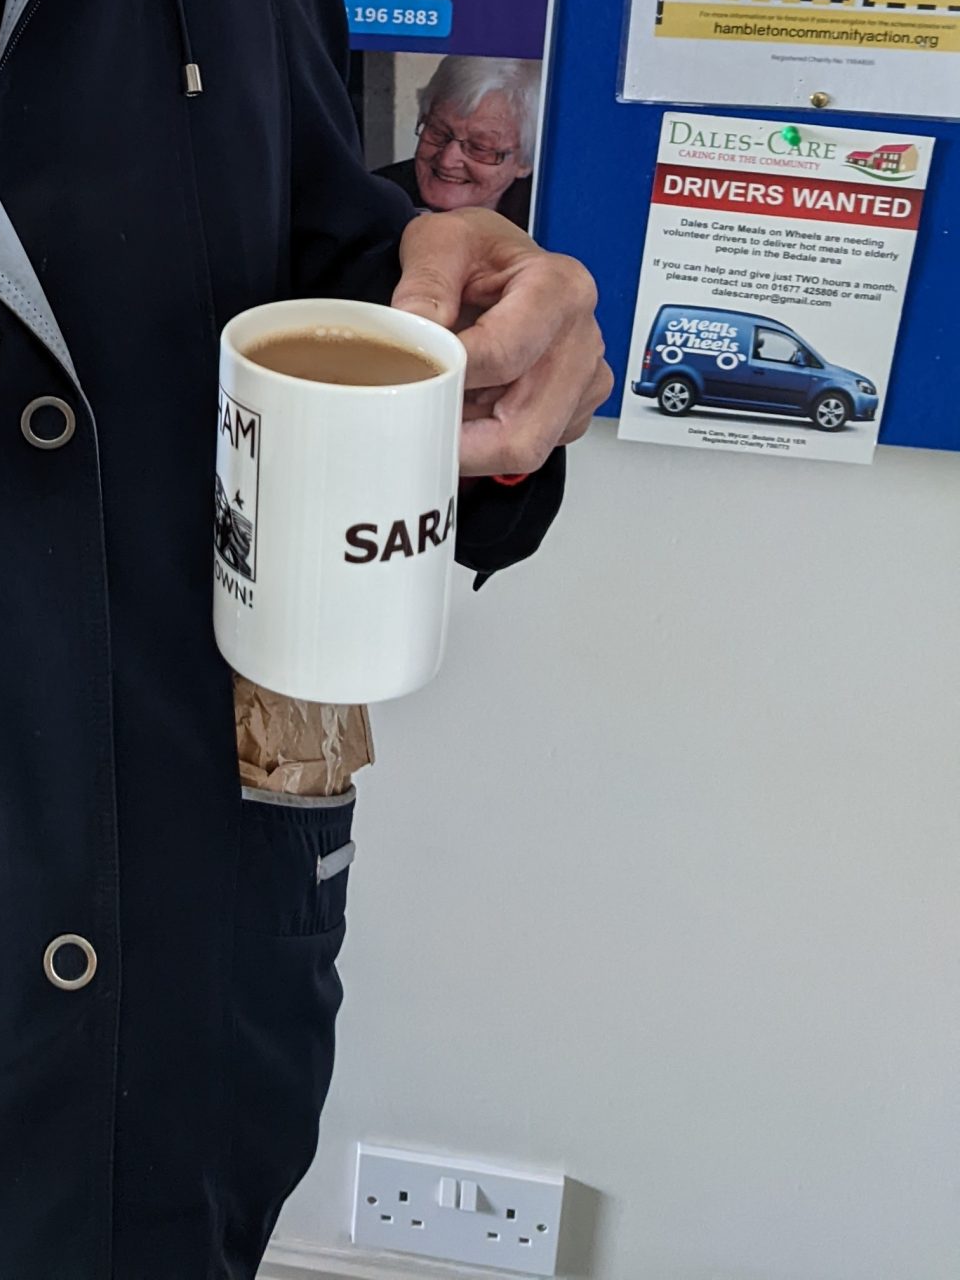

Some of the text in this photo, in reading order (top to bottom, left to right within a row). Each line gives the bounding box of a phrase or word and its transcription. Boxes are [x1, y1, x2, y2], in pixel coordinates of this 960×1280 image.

[354, 6, 438, 25] 196 5883
[679, 150, 820, 171] CARING FOR THE COMMUNITY
[664, 175, 912, 219] DRIVERS WANTED
[668, 318, 737, 338] Meals
[701, 330, 718, 339] on
[665, 331, 739, 353] Wheels
